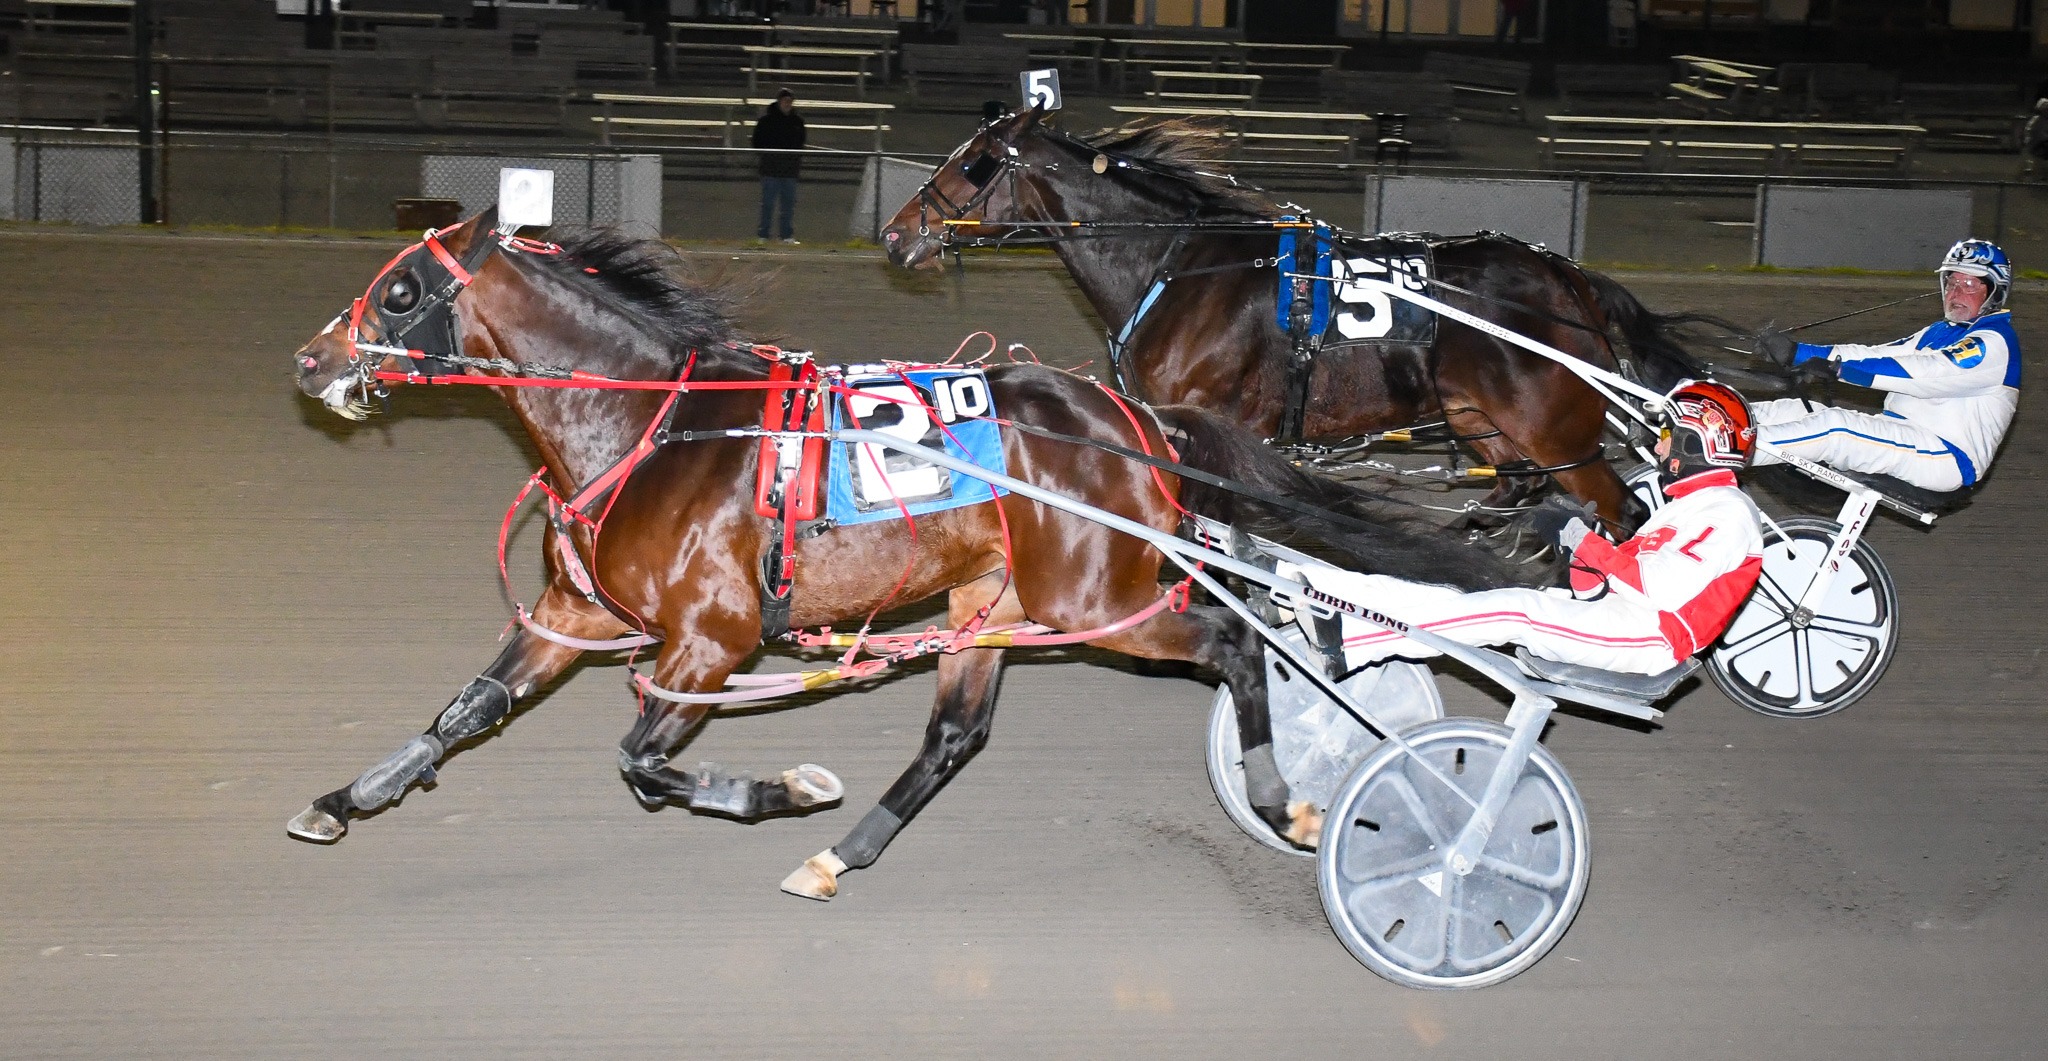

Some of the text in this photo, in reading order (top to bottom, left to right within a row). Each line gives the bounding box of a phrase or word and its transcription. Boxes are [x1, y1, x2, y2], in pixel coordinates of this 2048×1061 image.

[1029, 69, 1055, 110] 5
[1331, 257, 1393, 339] 5
[933, 376, 989, 424] 10
[849, 384, 940, 504] 2
[1780, 450, 1846, 484] BIG SKY RANCH
[1676, 524, 1718, 565] L
[1303, 586, 1409, 633] CHRIS LONG
